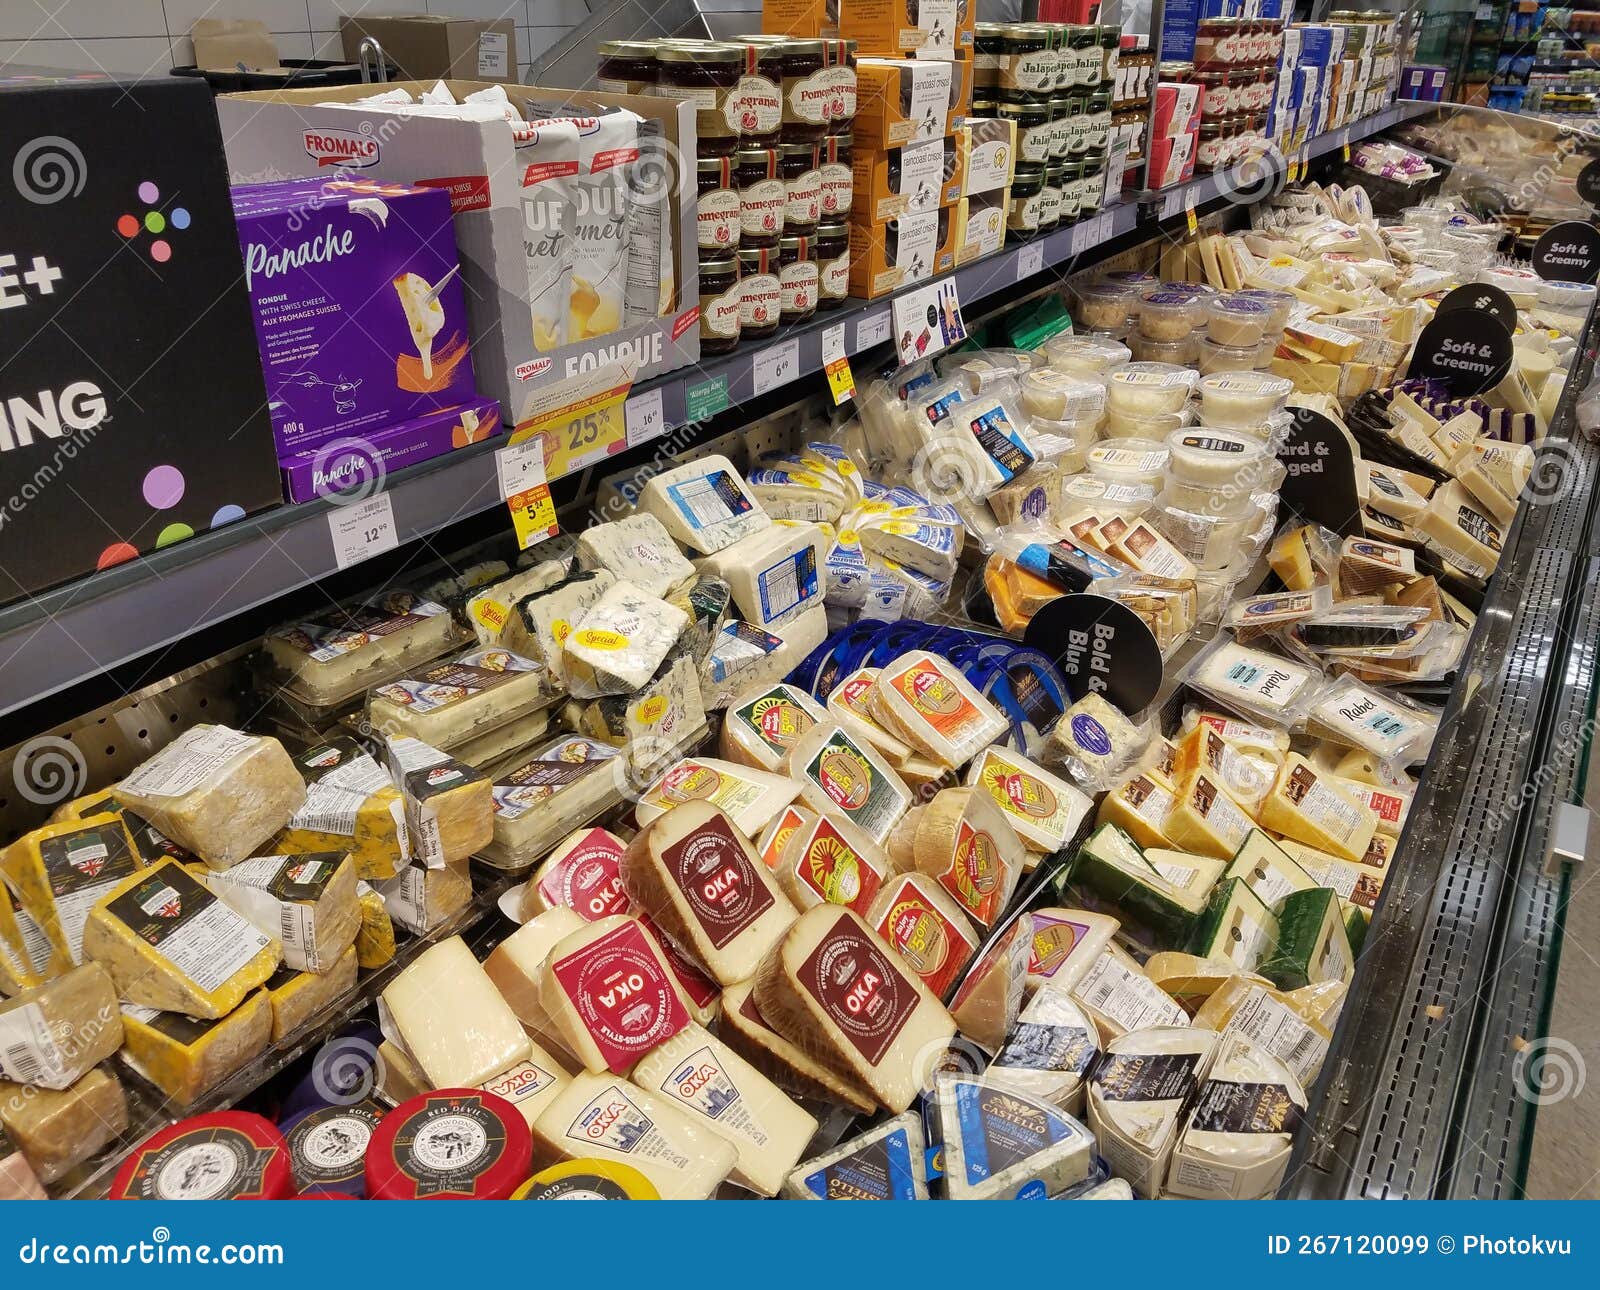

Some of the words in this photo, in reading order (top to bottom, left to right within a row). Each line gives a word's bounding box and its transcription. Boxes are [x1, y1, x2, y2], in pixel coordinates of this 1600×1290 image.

[304, 134, 377, 158] FROMALP
[454, 182, 472, 194] SUISSE
[244, 224, 355, 291] Panache
[1543, 252, 1591, 268] Creamy
[1550, 242, 1578, 256] Soft
[1579, 244, 1589, 255] &
[257, 293, 288, 306] FONDUE
[260, 306, 279, 316] WITH
[280, 302, 301, 312] SWISS
[302, 296, 326, 307] CHEESE
[262, 317, 278, 326] AUX
[278, 309, 315, 322] FROMAGES
[315, 303, 341, 315] SUISSES
[1441, 339, 1477, 356] Soft
[1478, 346, 1492, 358] &
[515, 359, 551, 375] FROMALP
[1432, 352, 1496, 376] Creamy
[282, 423, 297, 434] 400
[1313, 441, 1330, 456] &
[312, 456, 366, 494] Panache
[1287, 458, 1324, 477] ged
[481, 602, 508, 625] Special
[585, 631, 619, 648] Special
[1090, 623, 1116, 673] Bold
[1065, 630, 1089, 675] Blue
[1087, 675, 1109, 693] &
[1259, 669, 1290, 699] Rabel
[643, 702, 663, 720] Special
[1339, 696, 1377, 722] Rabel
[589, 876, 625, 914] OKA
[704, 868, 740, 900] OKA
[895, 914, 910, 935] Enjoy
[901, 914, 918, 941] tonight
[916, 915, 931, 937] OFF
[598, 974, 644, 1008] OKA
[846, 972, 880, 1012] OKA
[491, 1069, 538, 1096] OKA
[679, 1064, 719, 1098] OKA
[349, 1107, 373, 1119] ROCK
[427, 1106, 449, 1118] RED
[452, 1105, 481, 1117] DEVIL
[587, 1102, 628, 1138] OKA
[982, 1102, 1046, 1136] CASTELLO
[538, 1182, 561, 1200] OOD
